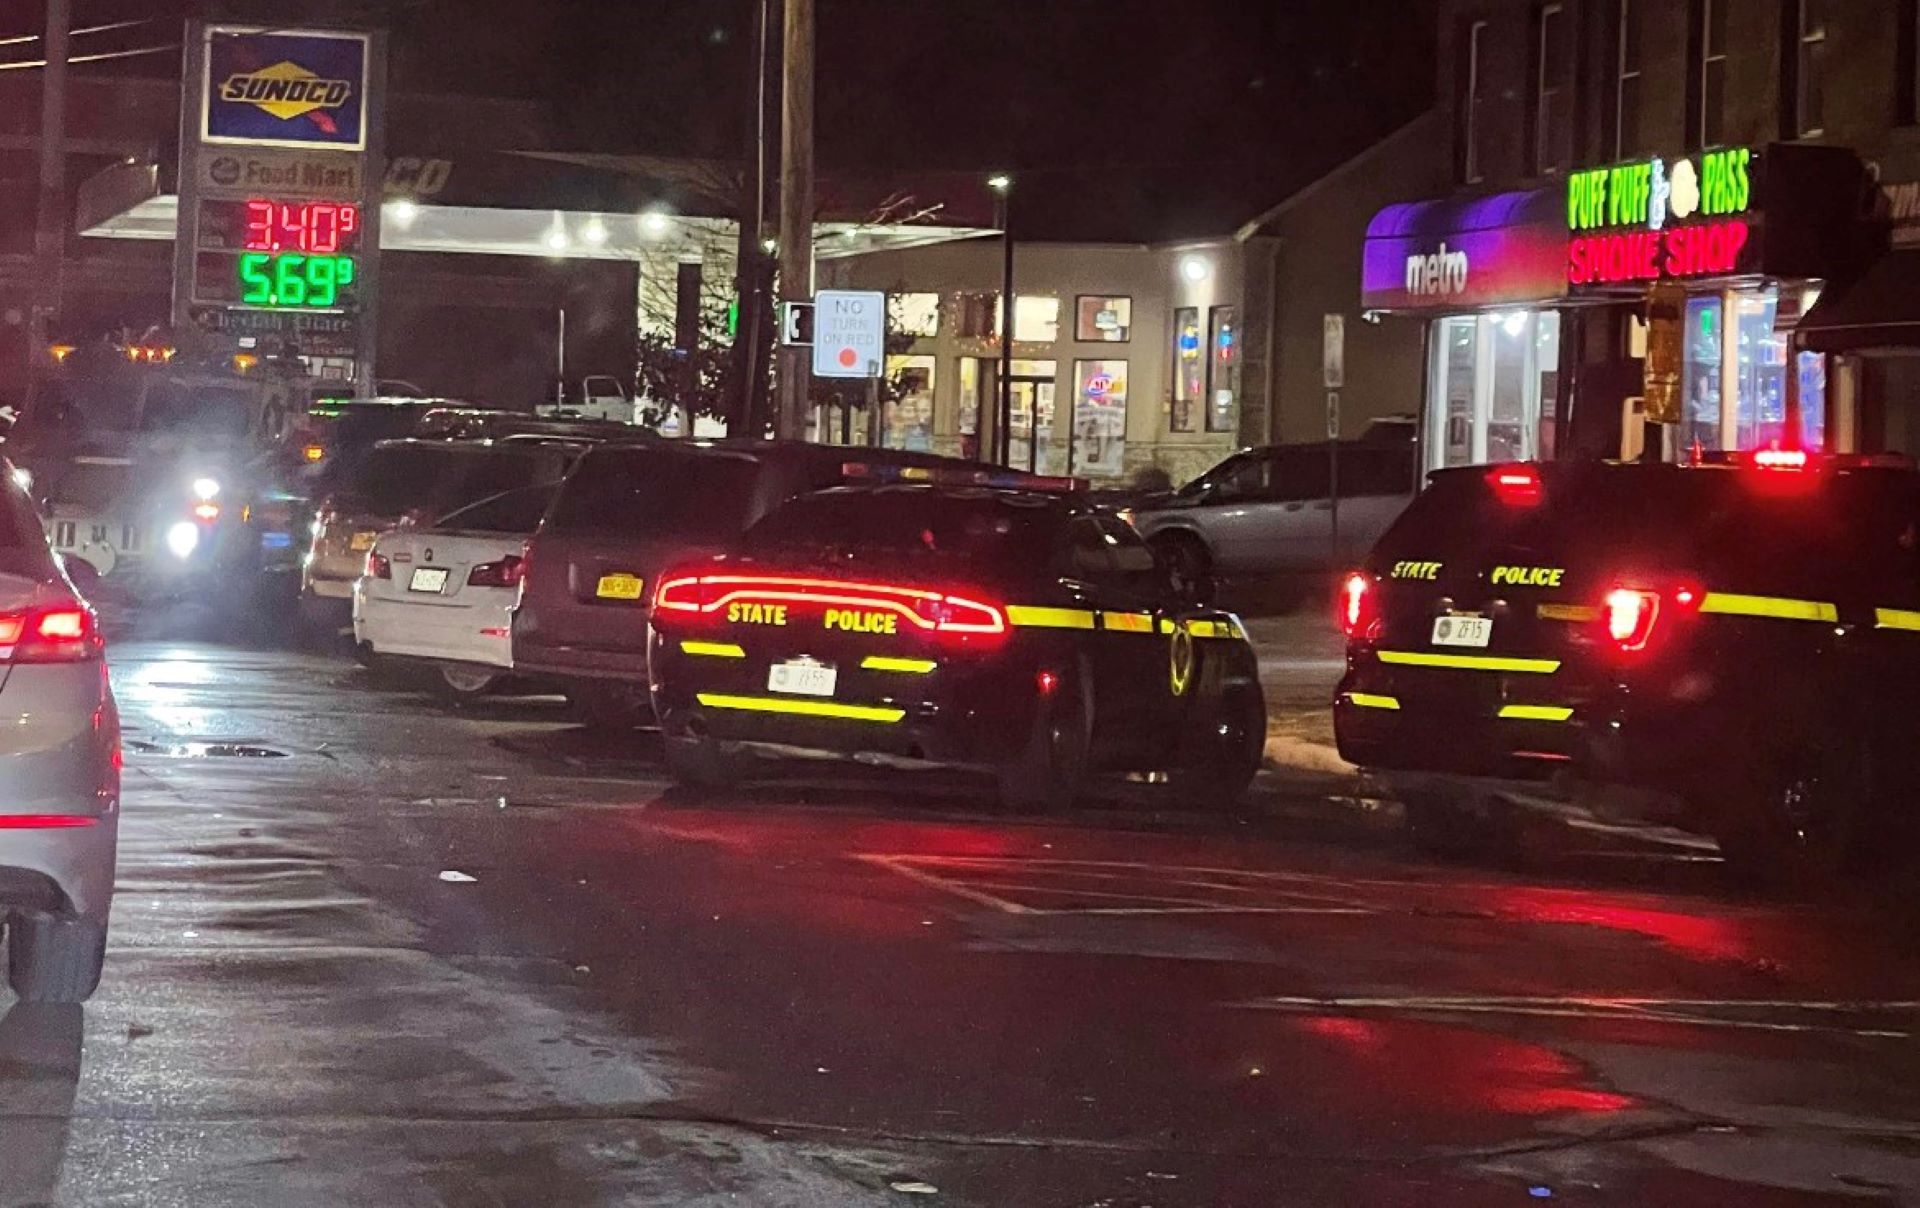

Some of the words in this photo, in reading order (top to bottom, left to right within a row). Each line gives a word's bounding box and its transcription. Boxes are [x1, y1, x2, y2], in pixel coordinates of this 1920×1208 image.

[225, 77, 347, 104] SUNOCO
[248, 160, 298, 185] Food
[303, 162, 354, 189] Mart
[1569, 170, 1608, 229] PUFF
[1609, 164, 1651, 225] PUFF
[1702, 149, 1749, 215] PASS
[1569, 234, 1660, 284] SMOKE
[1665, 221, 1748, 276] SHOP
[1406, 242, 1468, 295] metro
[835, 300, 864, 314] NO
[831, 318, 869, 330] TURN
[823, 333, 841, 345] ON
[846, 333, 875, 346] RED
[1391, 561, 1442, 580] STATE
[1491, 566, 1565, 587] POLICE
[727, 602, 787, 626] STATE
[824, 609, 898, 634] POLICE
